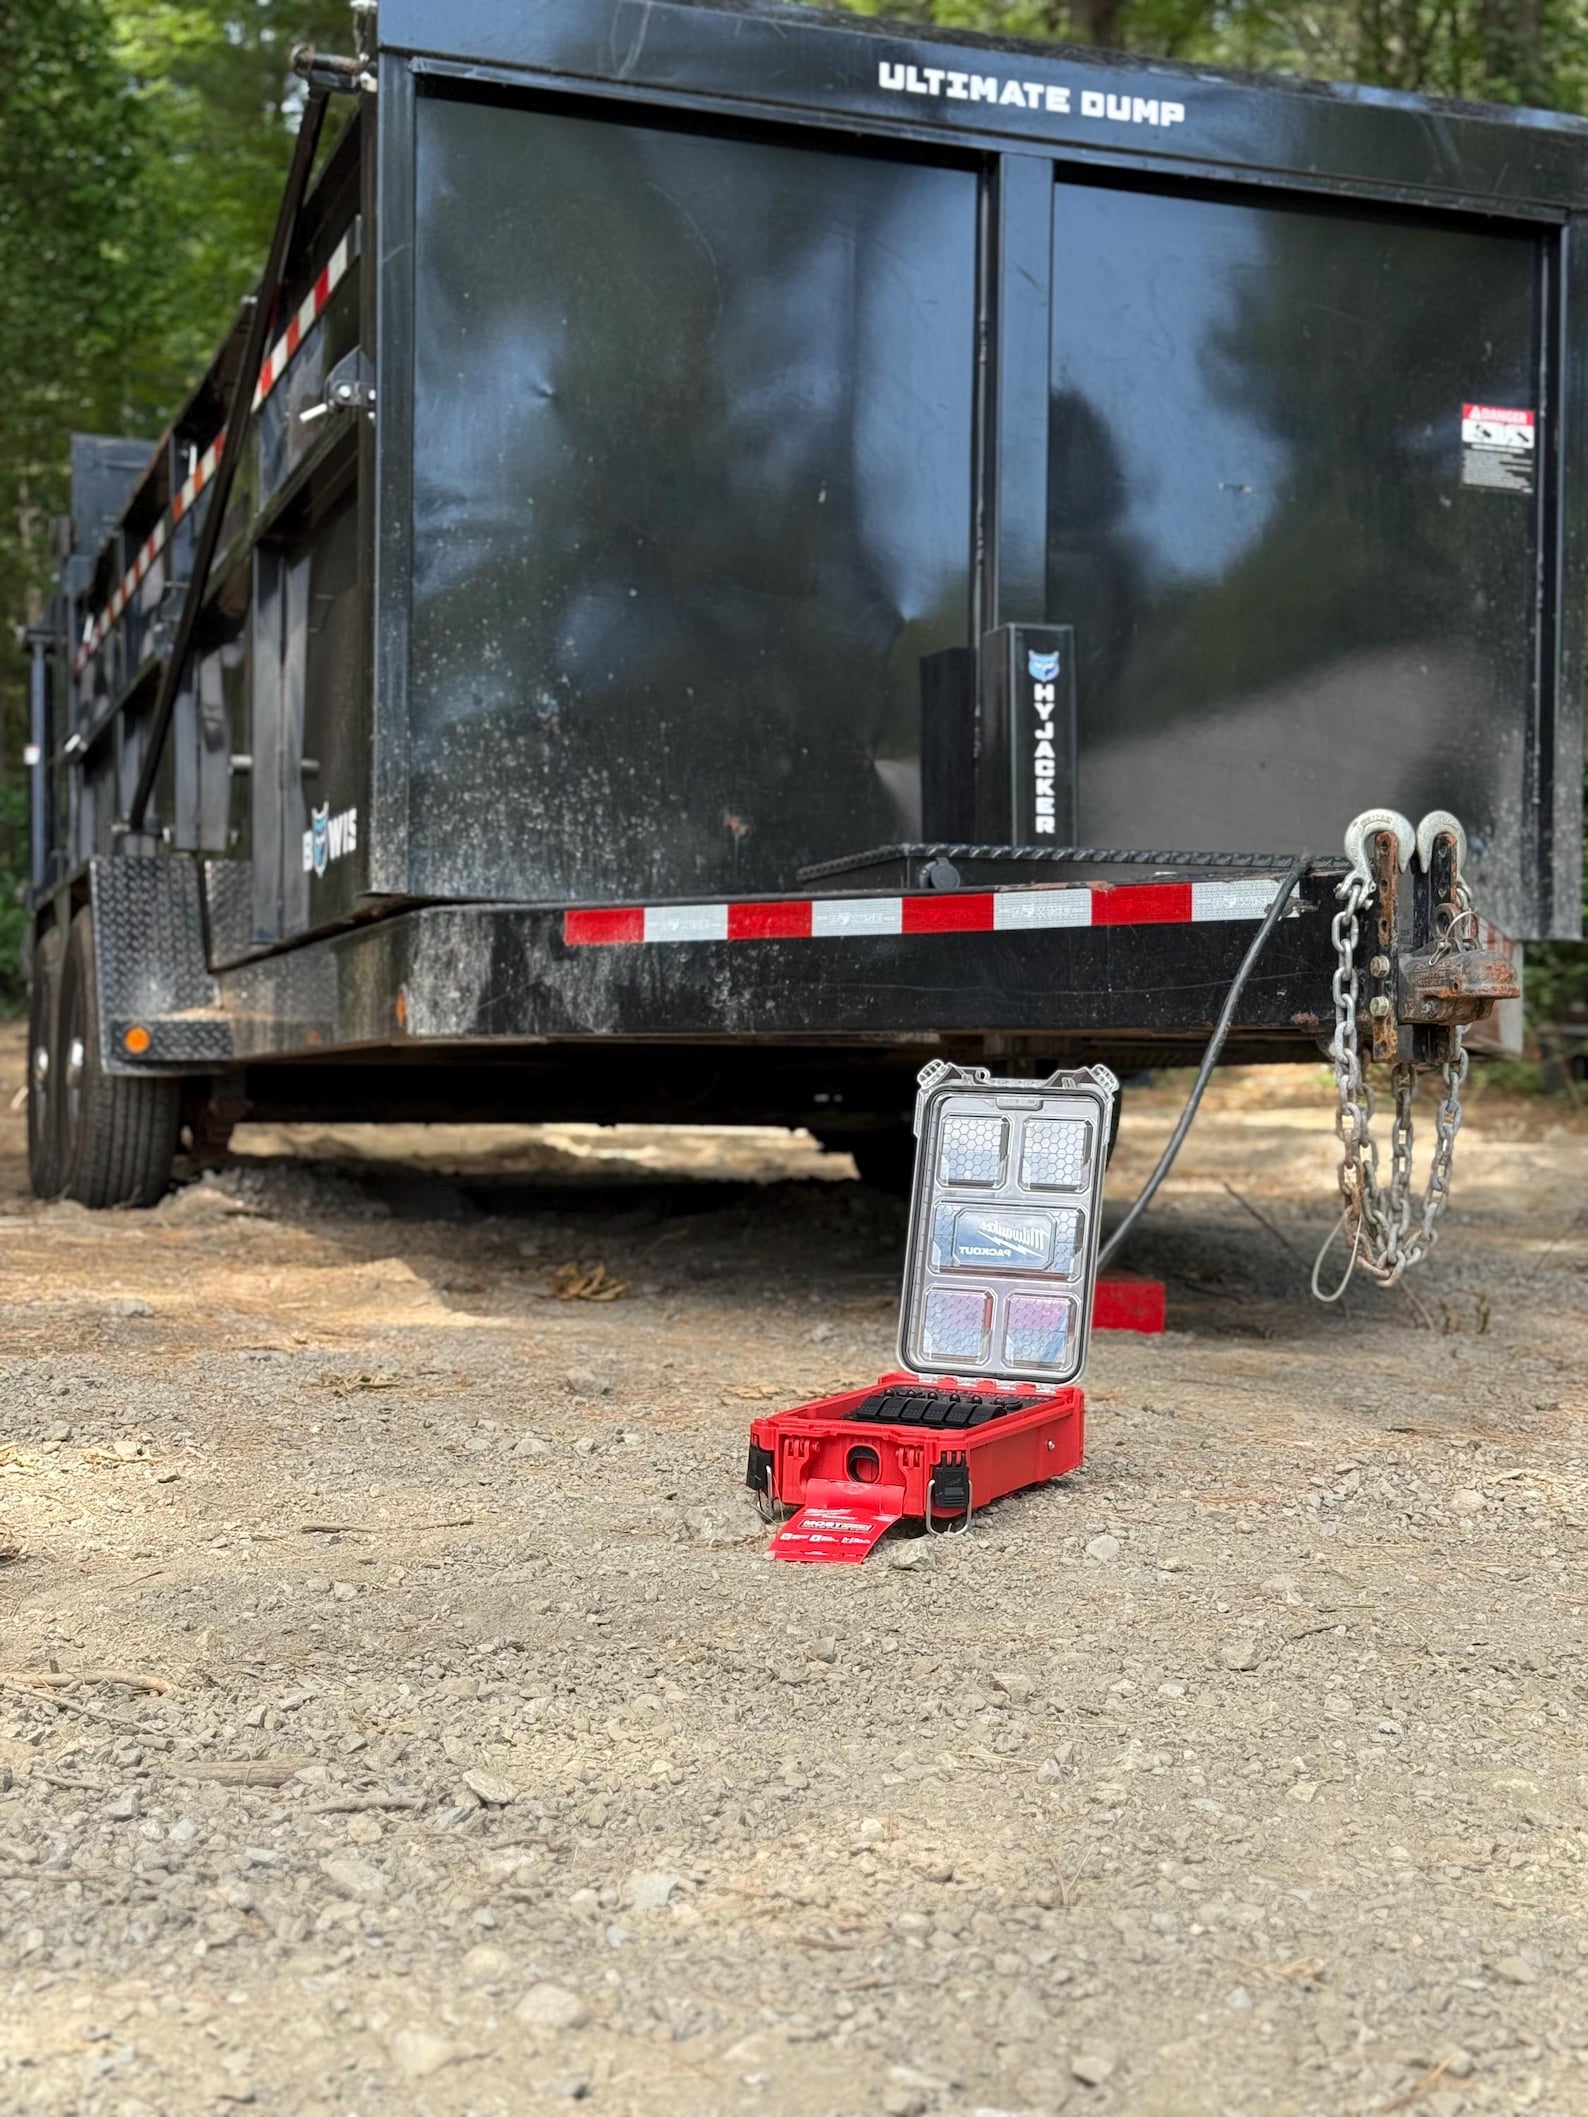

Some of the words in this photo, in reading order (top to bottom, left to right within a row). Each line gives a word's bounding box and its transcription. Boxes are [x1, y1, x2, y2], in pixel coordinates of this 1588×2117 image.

[879, 62, 1070, 113] ULTIMATE
[1081, 90, 1185, 127] DUMP
[1034, 683, 1056, 834] HYJACKER
